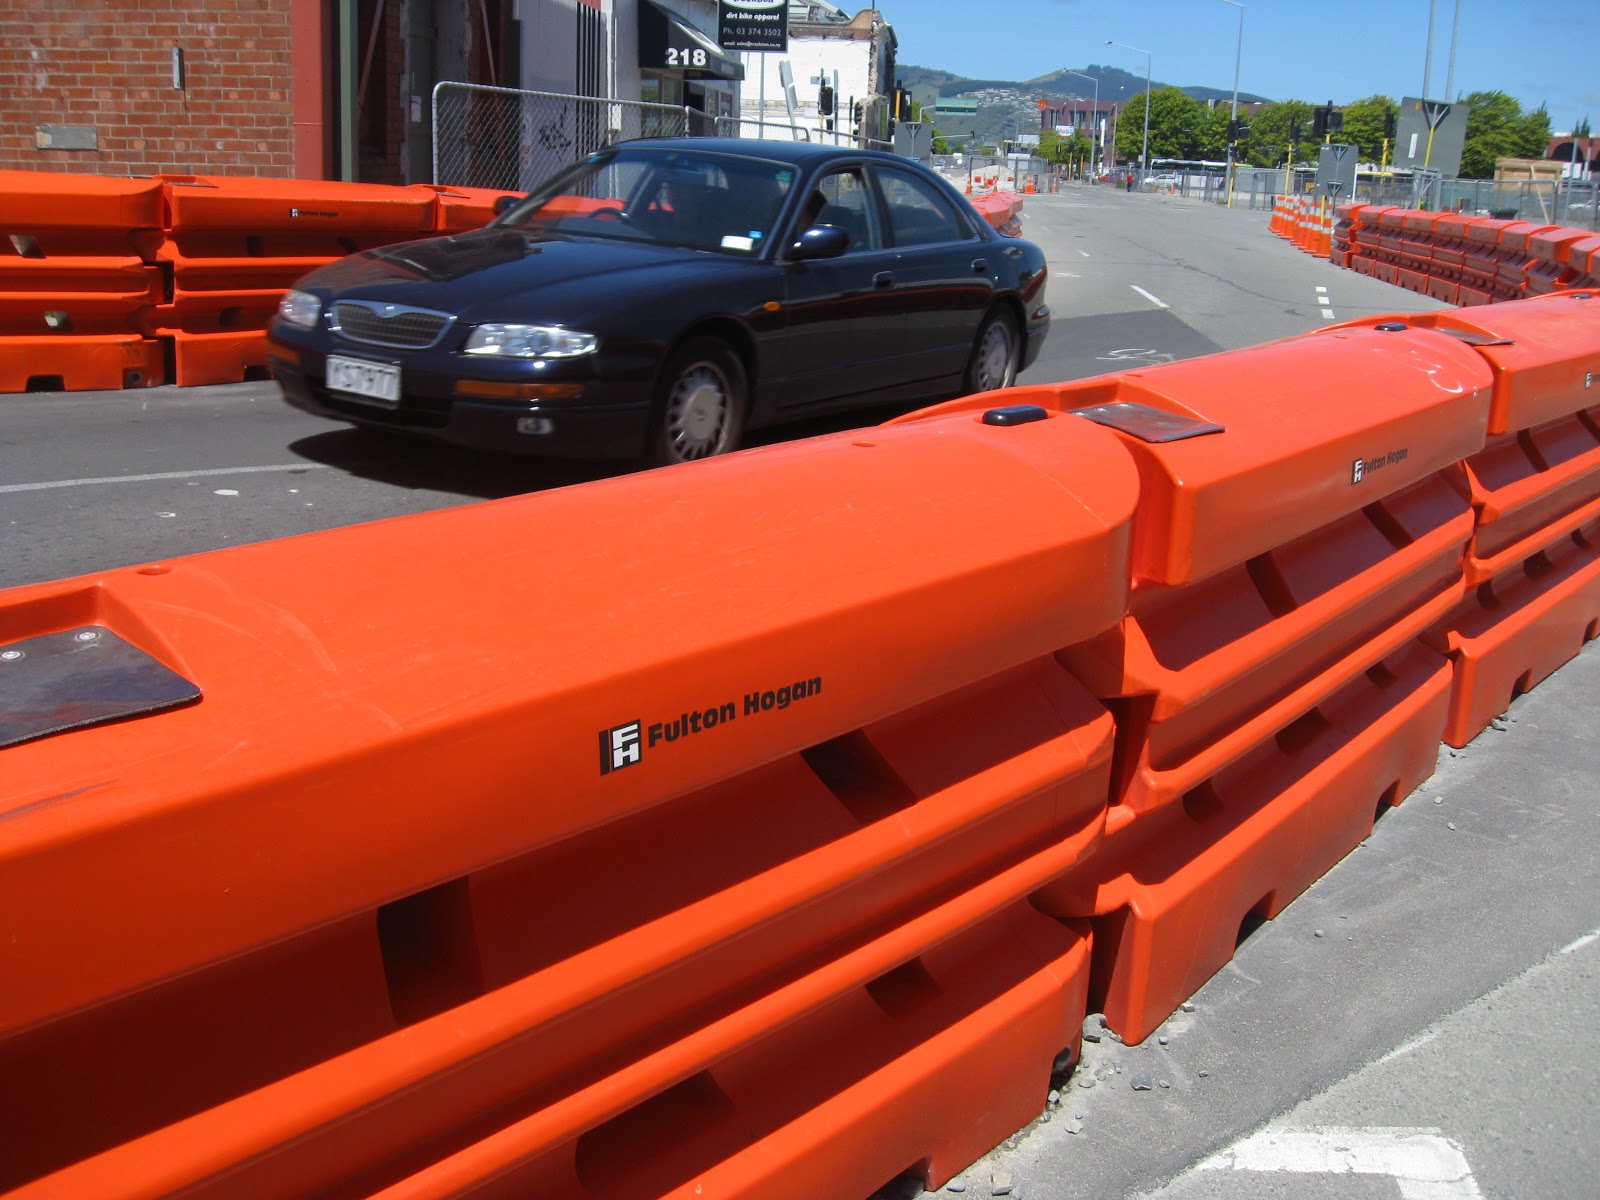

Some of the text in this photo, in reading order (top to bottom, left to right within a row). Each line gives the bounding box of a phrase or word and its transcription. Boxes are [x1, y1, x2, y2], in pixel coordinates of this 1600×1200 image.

[726, 11, 738, 19] dirt
[754, 13, 779, 21] apparel
[764, 28, 782, 36] 3502
[665, 48, 706, 66] 218
[1363, 448, 1409, 475] Fulton Hogan
[648, 676, 822, 749] Fulton Hogan
